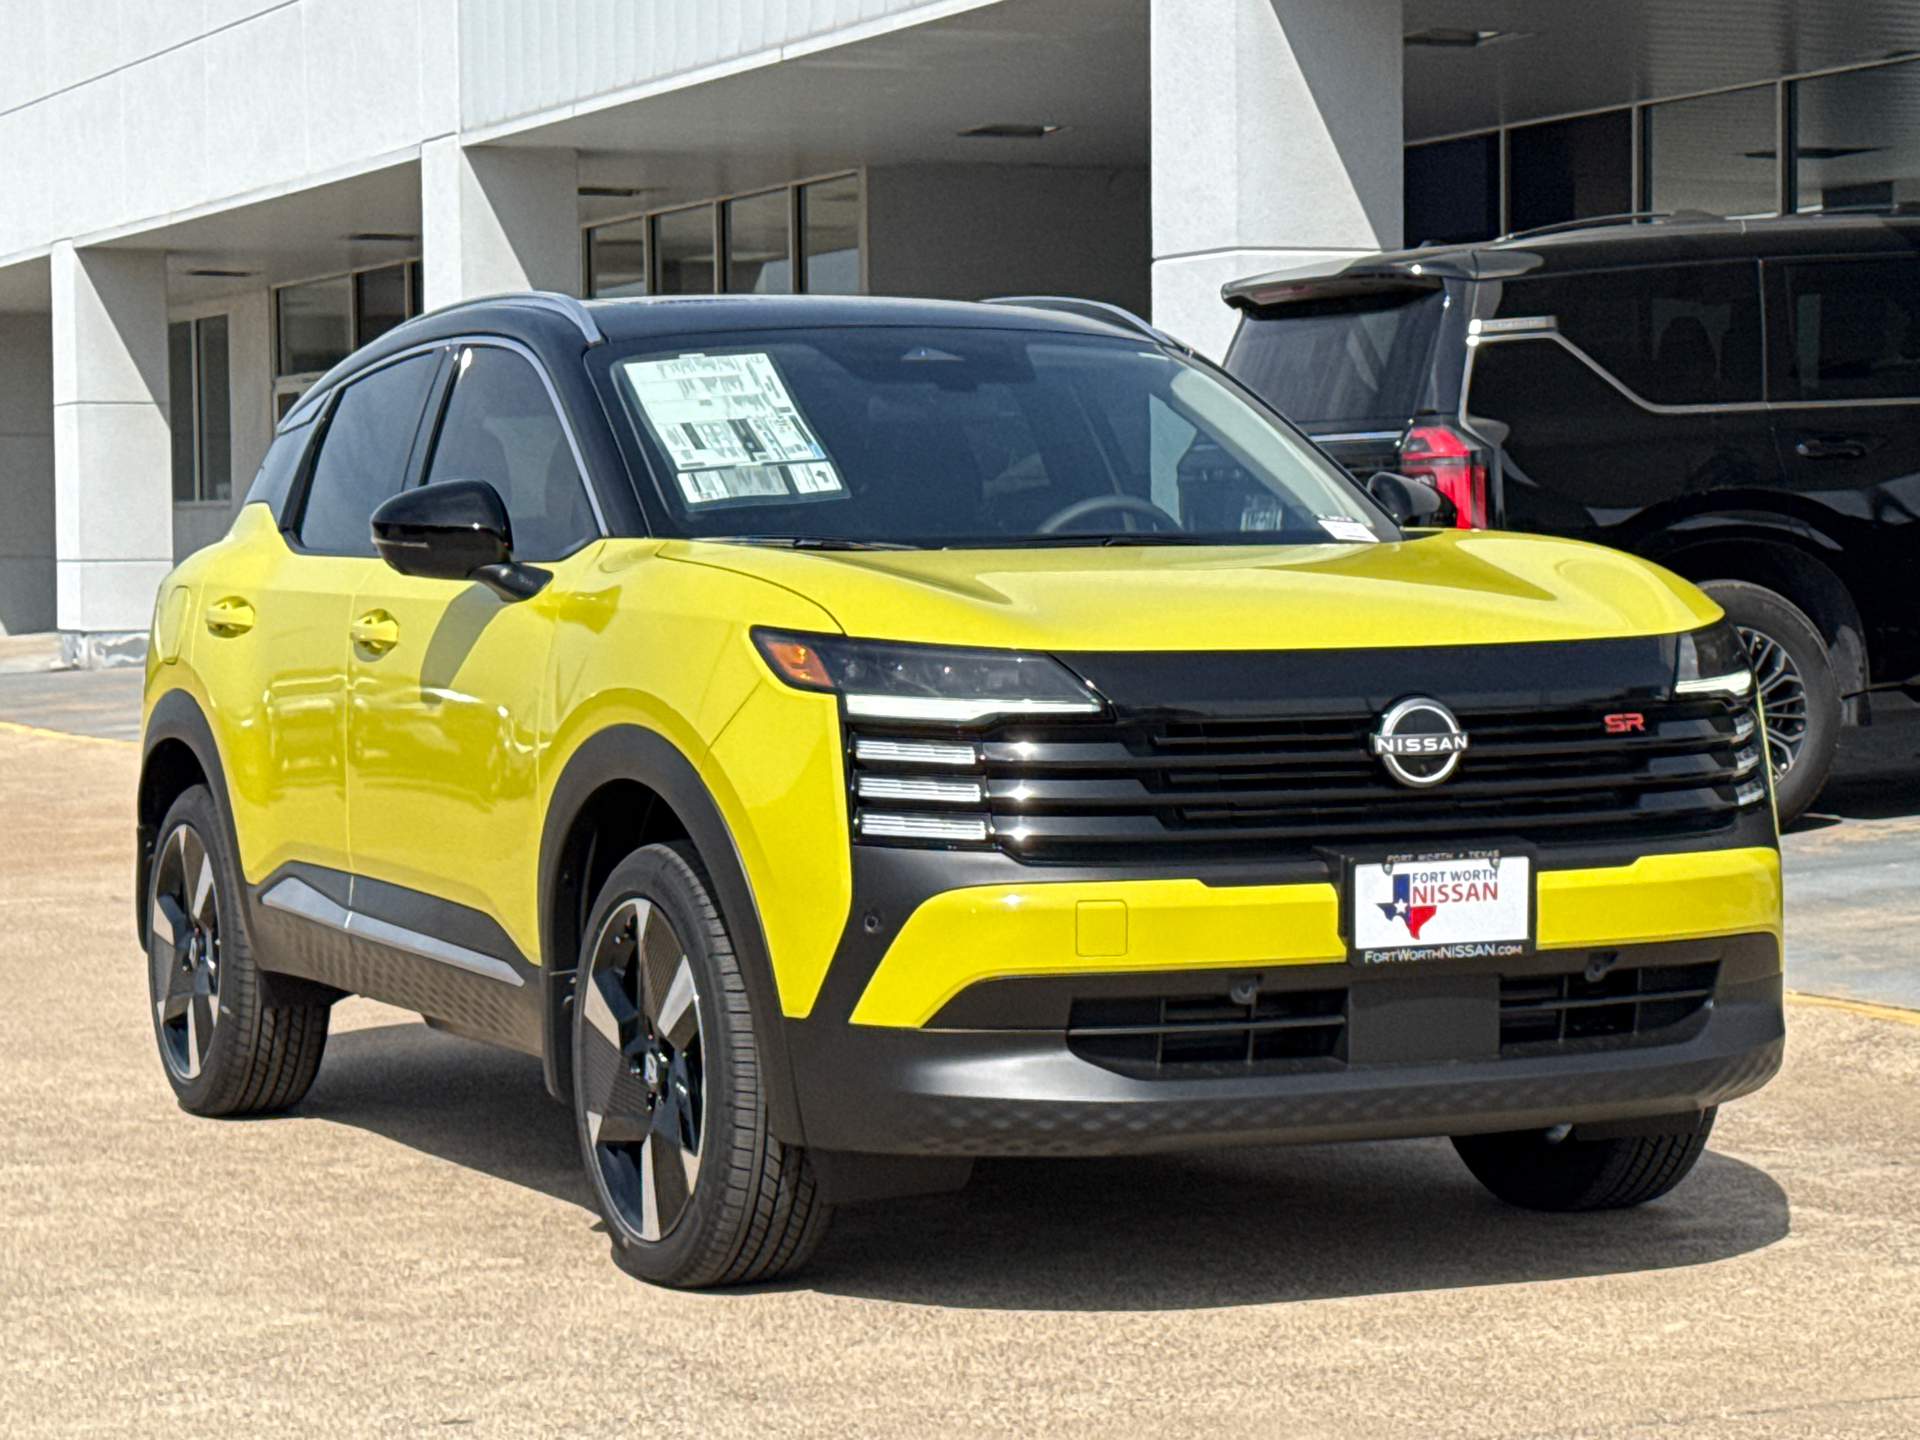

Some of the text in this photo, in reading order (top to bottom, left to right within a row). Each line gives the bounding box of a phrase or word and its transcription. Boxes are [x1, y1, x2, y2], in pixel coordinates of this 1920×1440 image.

[1604, 712, 1645, 732] SR
[1376, 734, 1468, 752] NISSAN
[1387, 850, 1500, 863] FORT WORTH TEXAS
[1412, 869, 1498, 884] FORT WORTH
[1412, 881, 1498, 904] NISSAN
